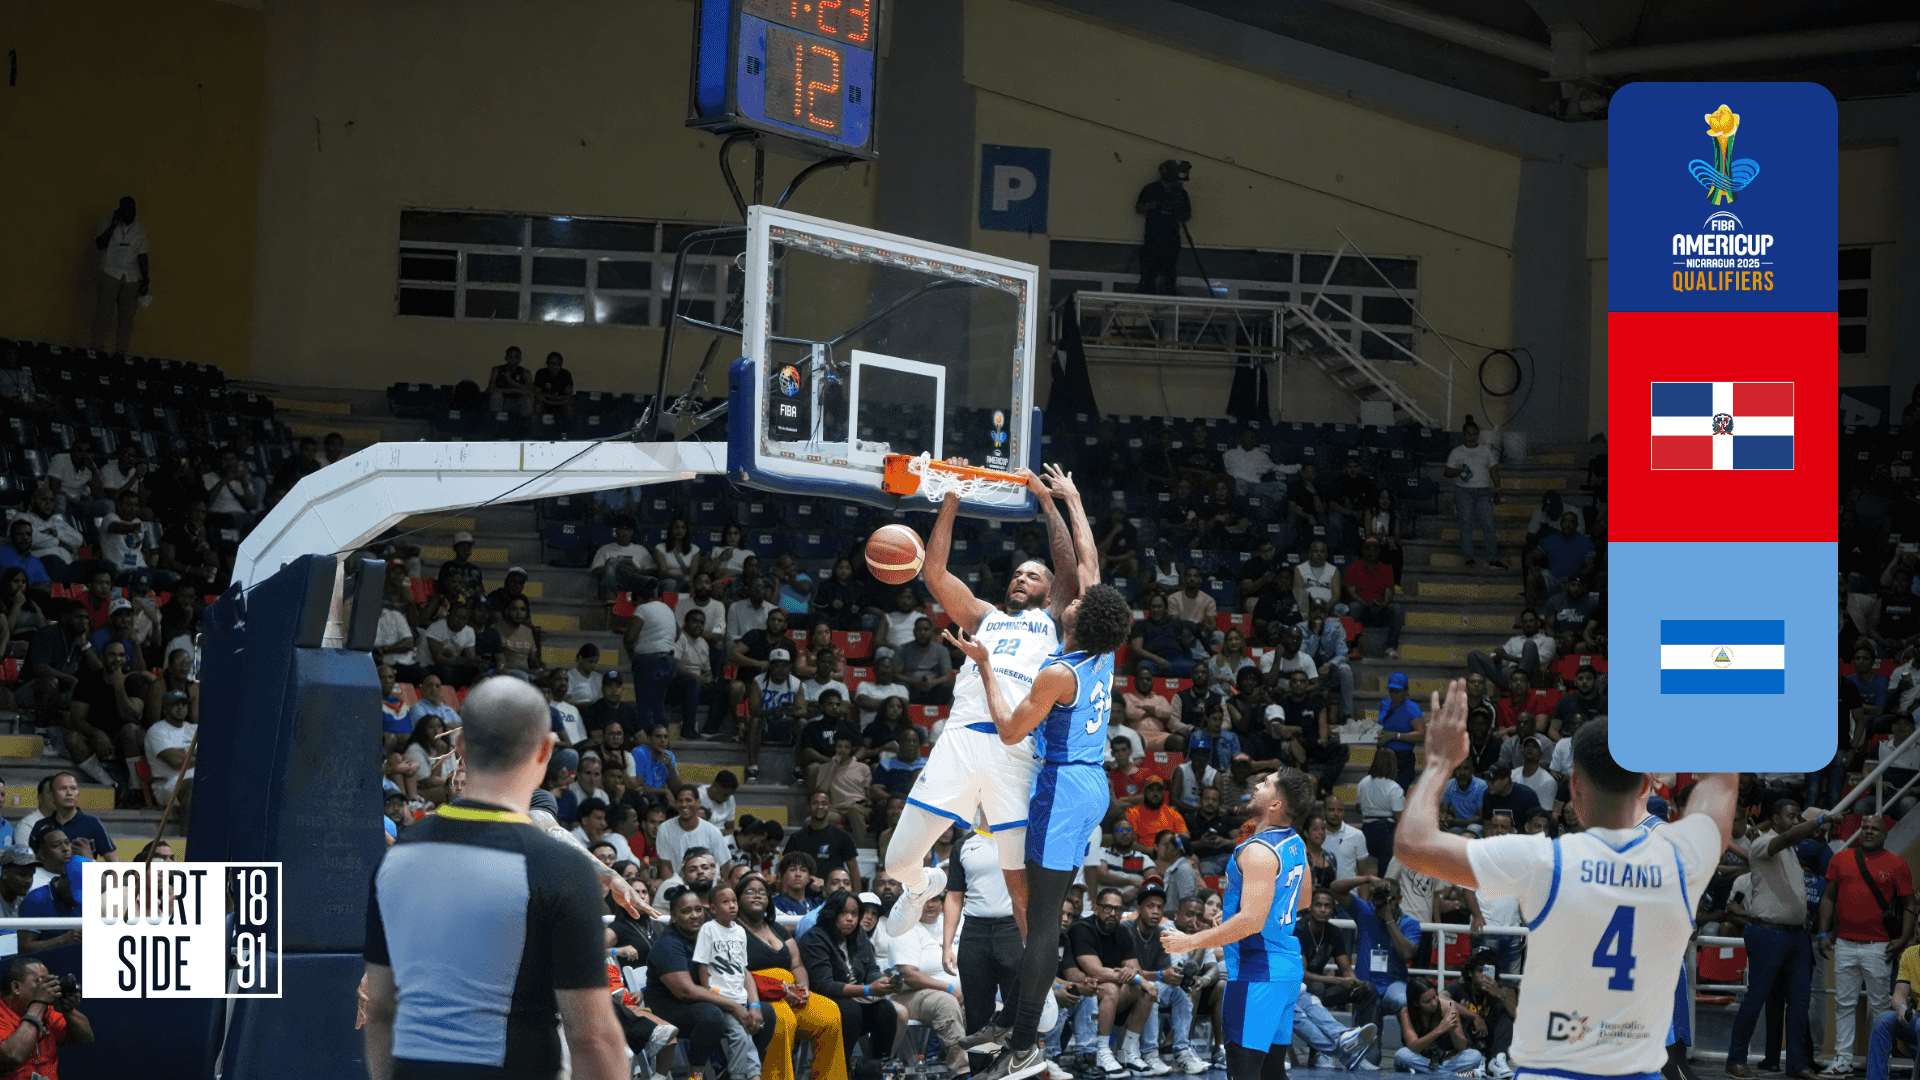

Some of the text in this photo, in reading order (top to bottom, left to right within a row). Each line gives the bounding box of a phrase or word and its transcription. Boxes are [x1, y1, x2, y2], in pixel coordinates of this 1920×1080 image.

[794, 45, 840, 128] 12
[992, 164, 1037, 211] P
[780, 403, 797, 418] FIBA
[985, 621, 1048, 635] DOMINICANA
[992, 638, 1021, 656] 22
[1592, 904, 1637, 992] 4
